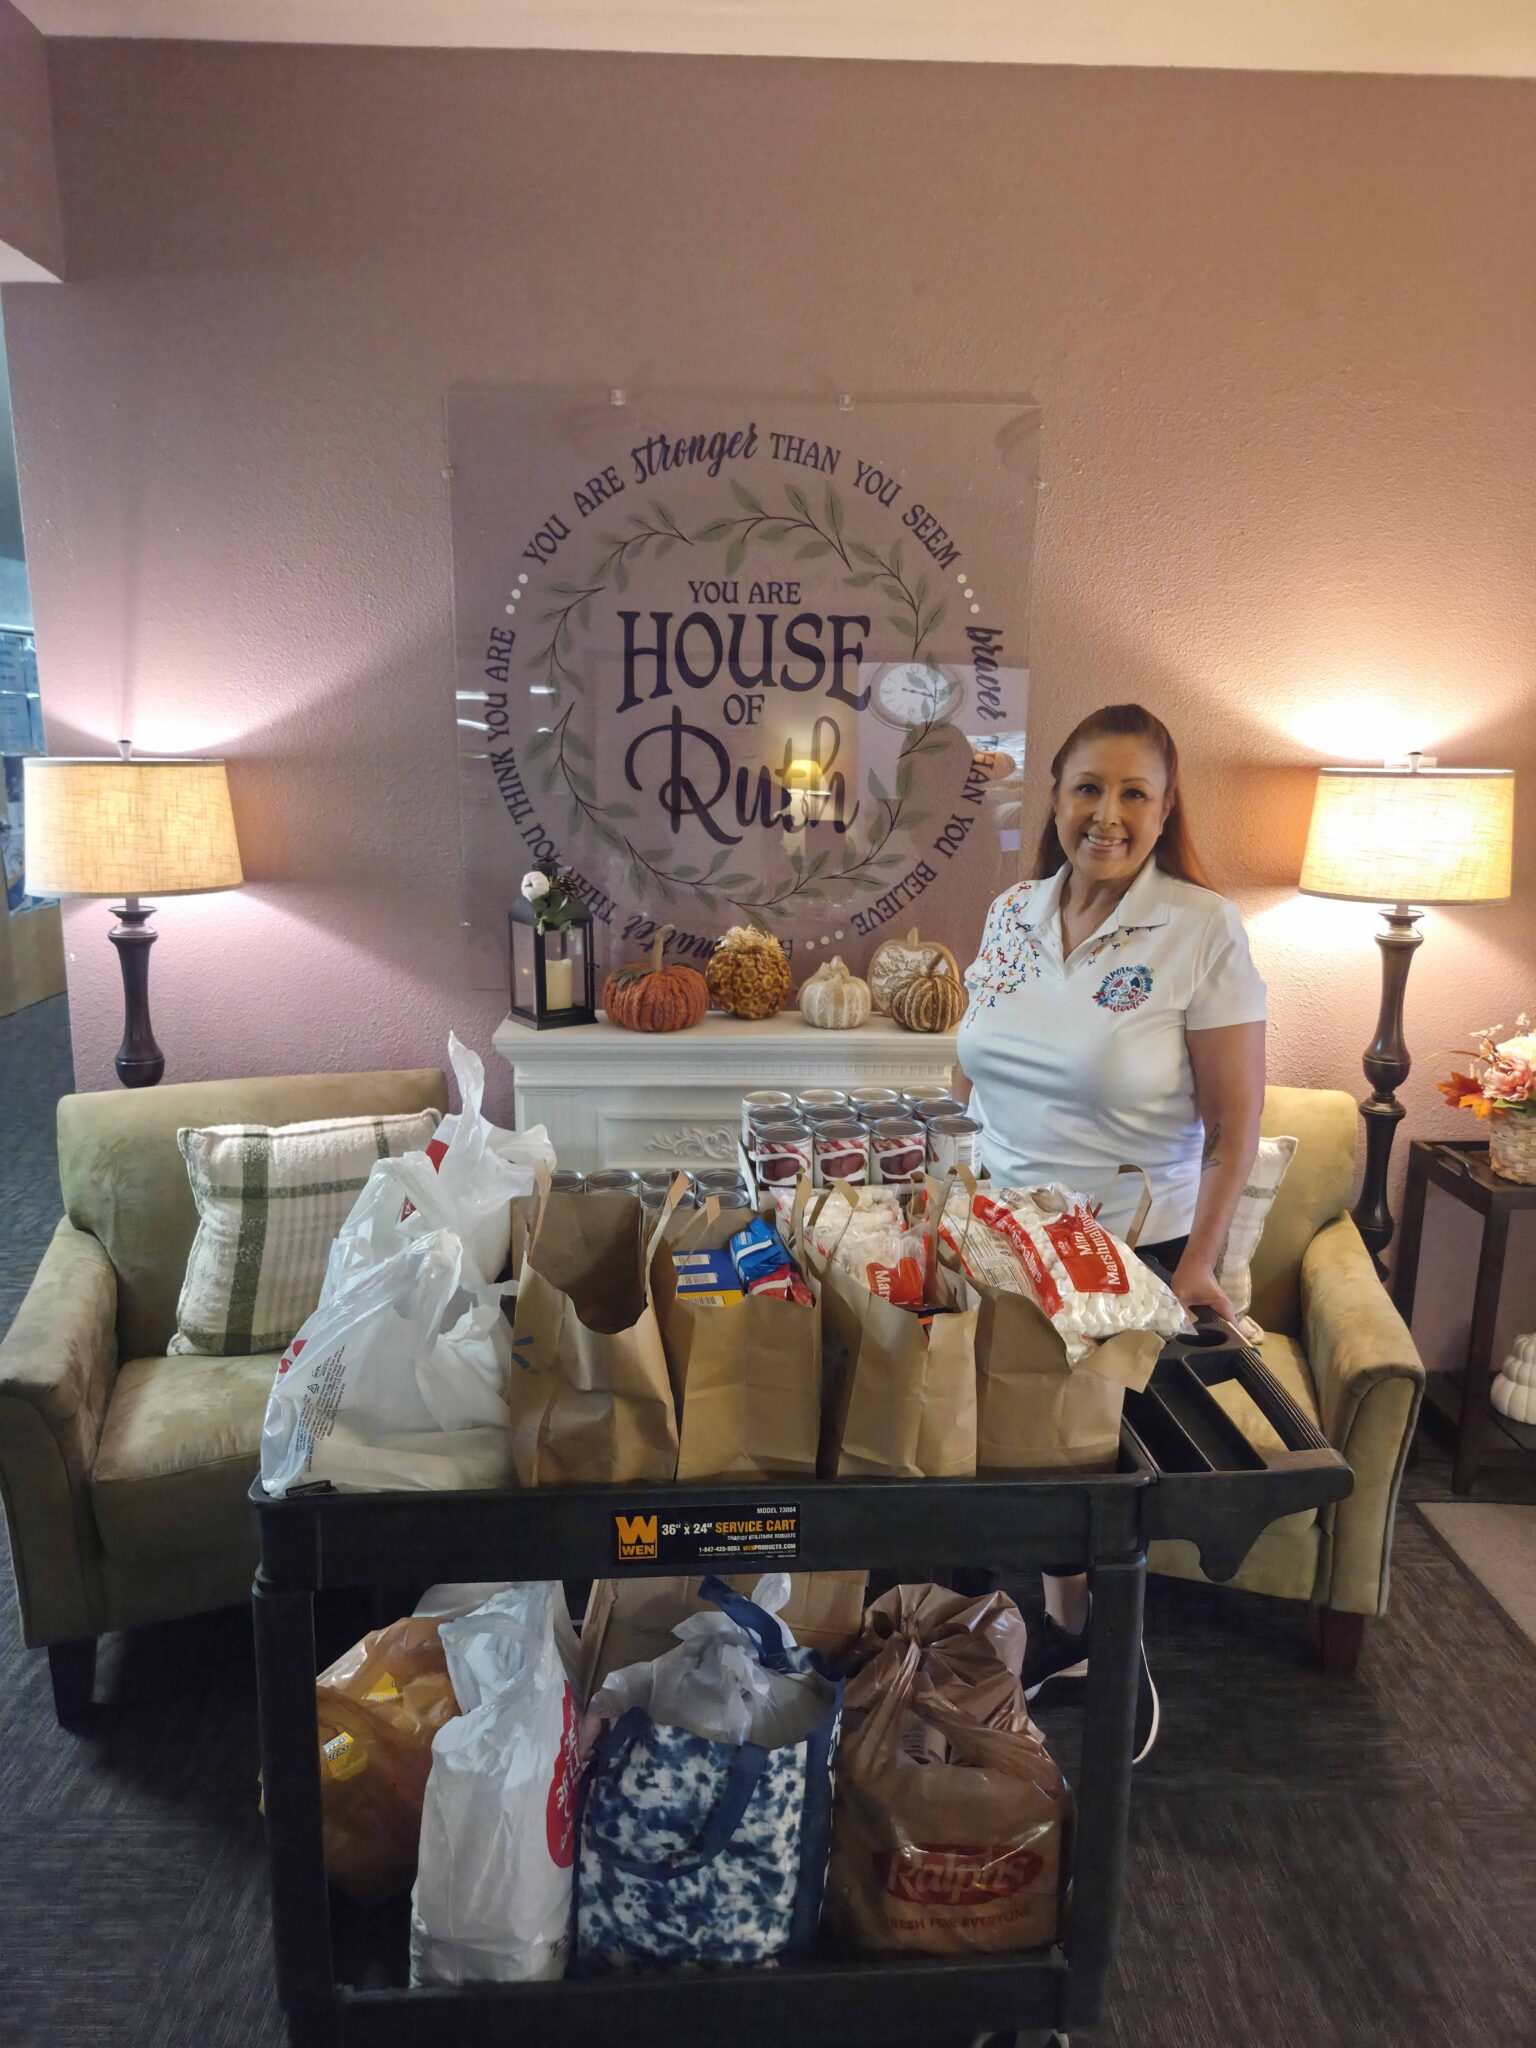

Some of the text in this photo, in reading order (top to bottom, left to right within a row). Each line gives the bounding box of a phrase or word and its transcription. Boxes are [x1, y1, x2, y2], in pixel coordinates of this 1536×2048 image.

[523, 422, 962, 570] YOU ARE stronger THAN YOU SEEM
[688, 580, 802, 605] YOU ARE
[484, 626, 516, 683] ARE
[616, 610, 872, 713] HOUSE
[484, 692, 509, 742] YOU
[723, 694, 765, 726] OF
[490, 747, 535, 825] THINK
[624, 704, 860, 845] Ruth
[850, 625, 1007, 936] braver THAN YOU BELIEVE
[1072, 1231, 1092, 1257] Mini
[621, 1544, 656, 1556] WEN
[661, 1523, 681, 1535] 36"
[693, 1522, 713, 1534] 24"
[715, 1520, 762, 1533] SERVICE
[766, 1519, 796, 1531] CART
